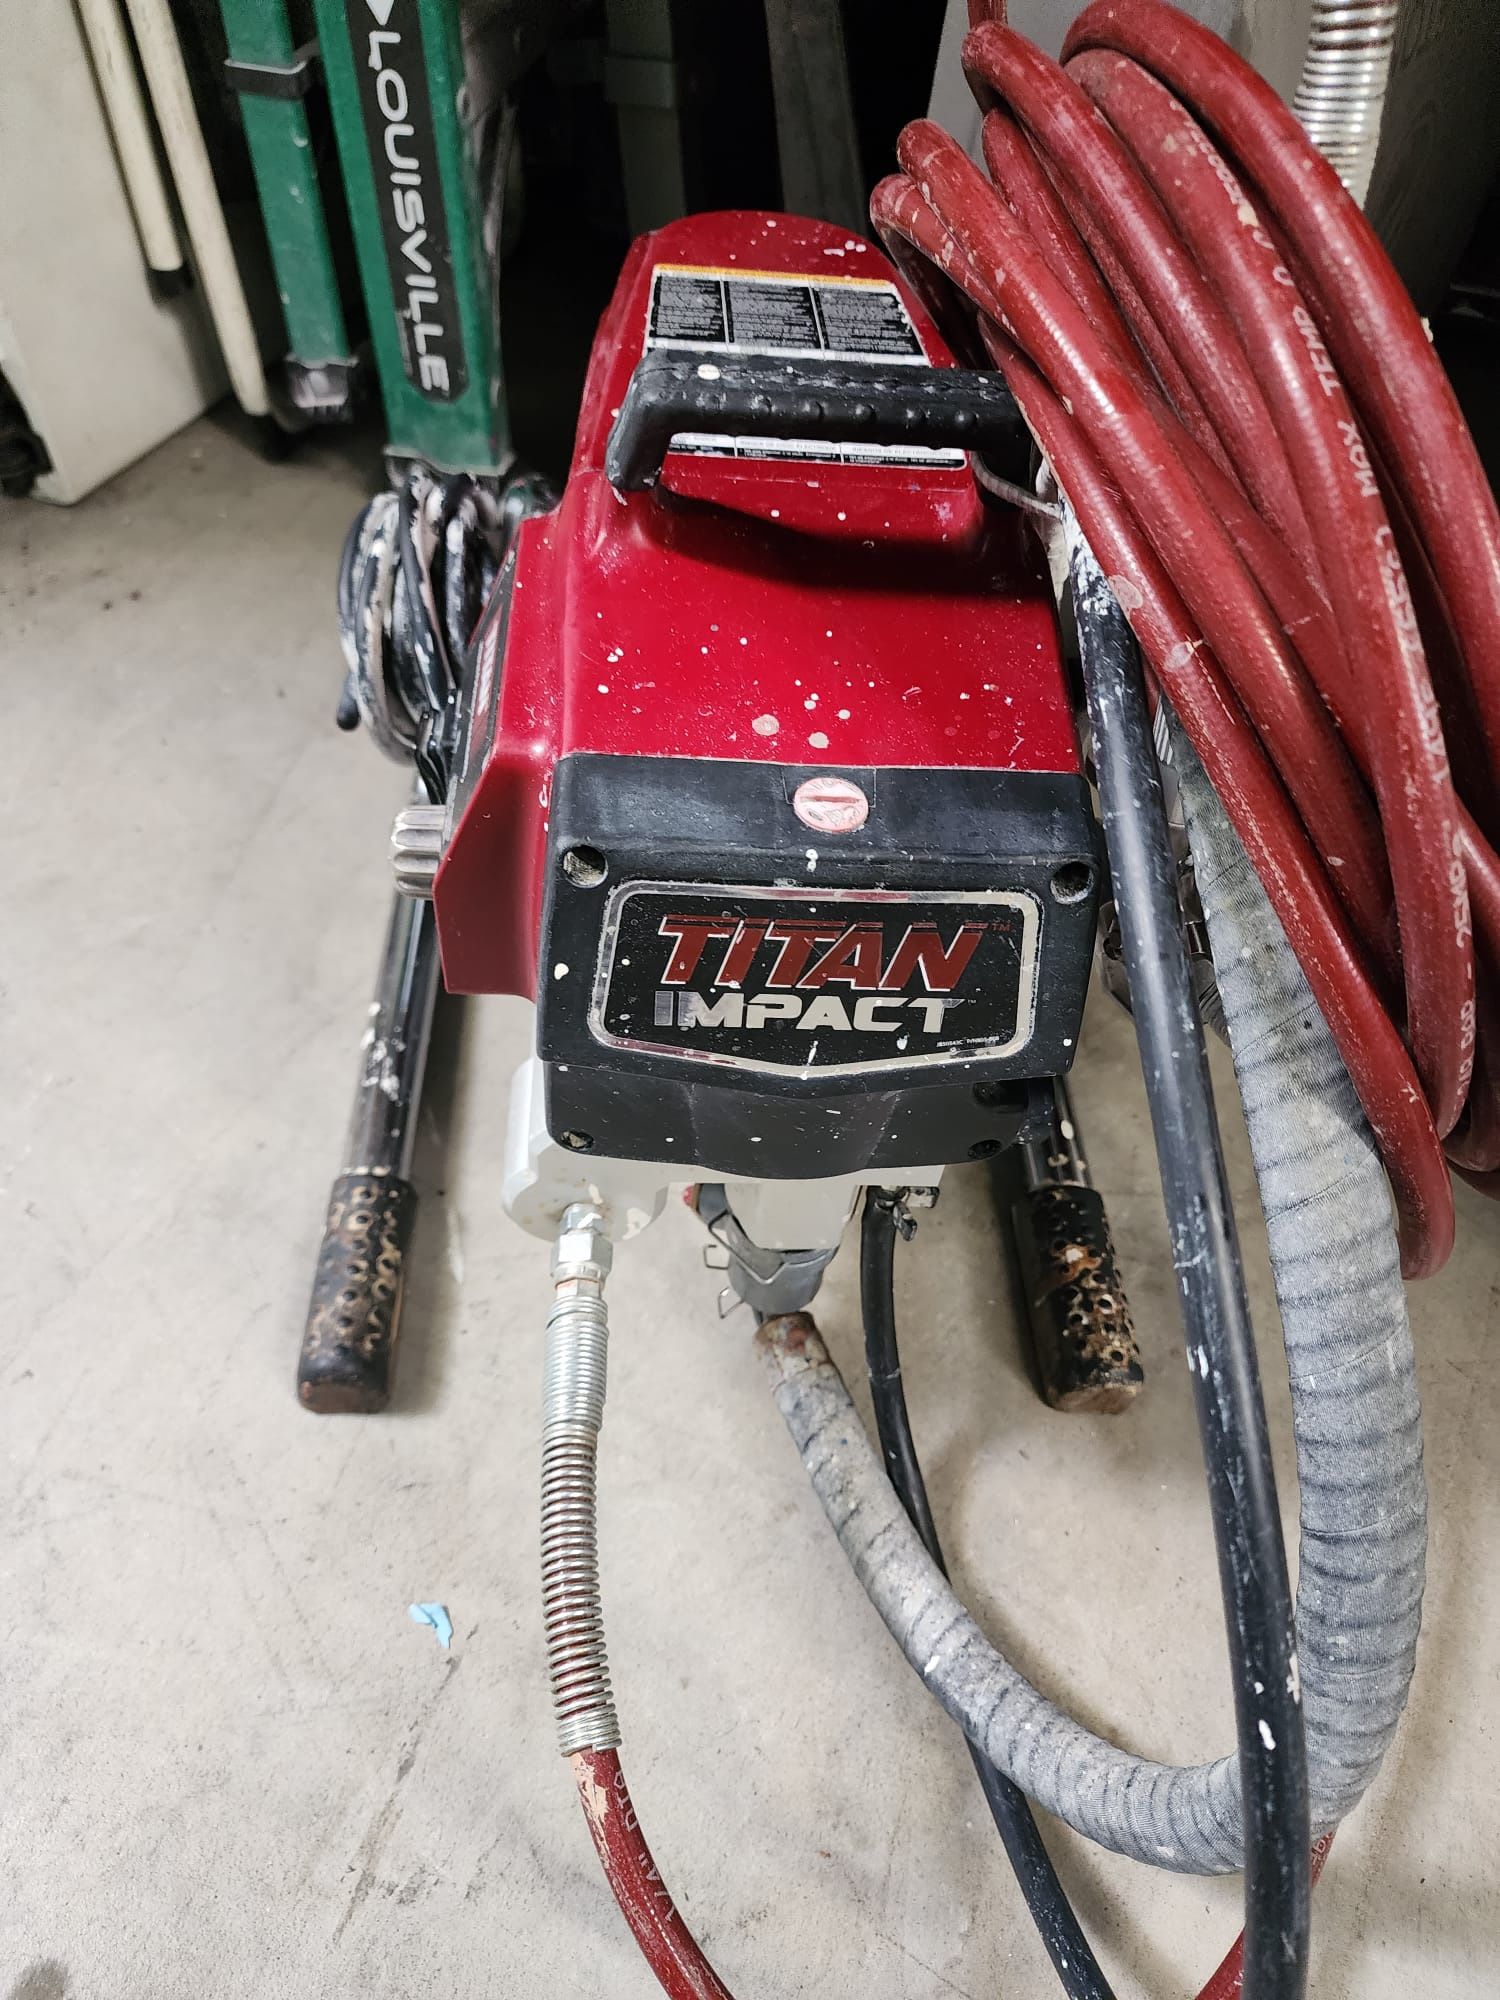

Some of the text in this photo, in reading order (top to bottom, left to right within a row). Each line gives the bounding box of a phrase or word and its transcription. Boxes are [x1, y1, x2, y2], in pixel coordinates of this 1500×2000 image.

[368, 30, 450, 393] LOUISVILLE
[658, 914, 989, 992] TITAN
[654, 990, 965, 1033] IMPACT
